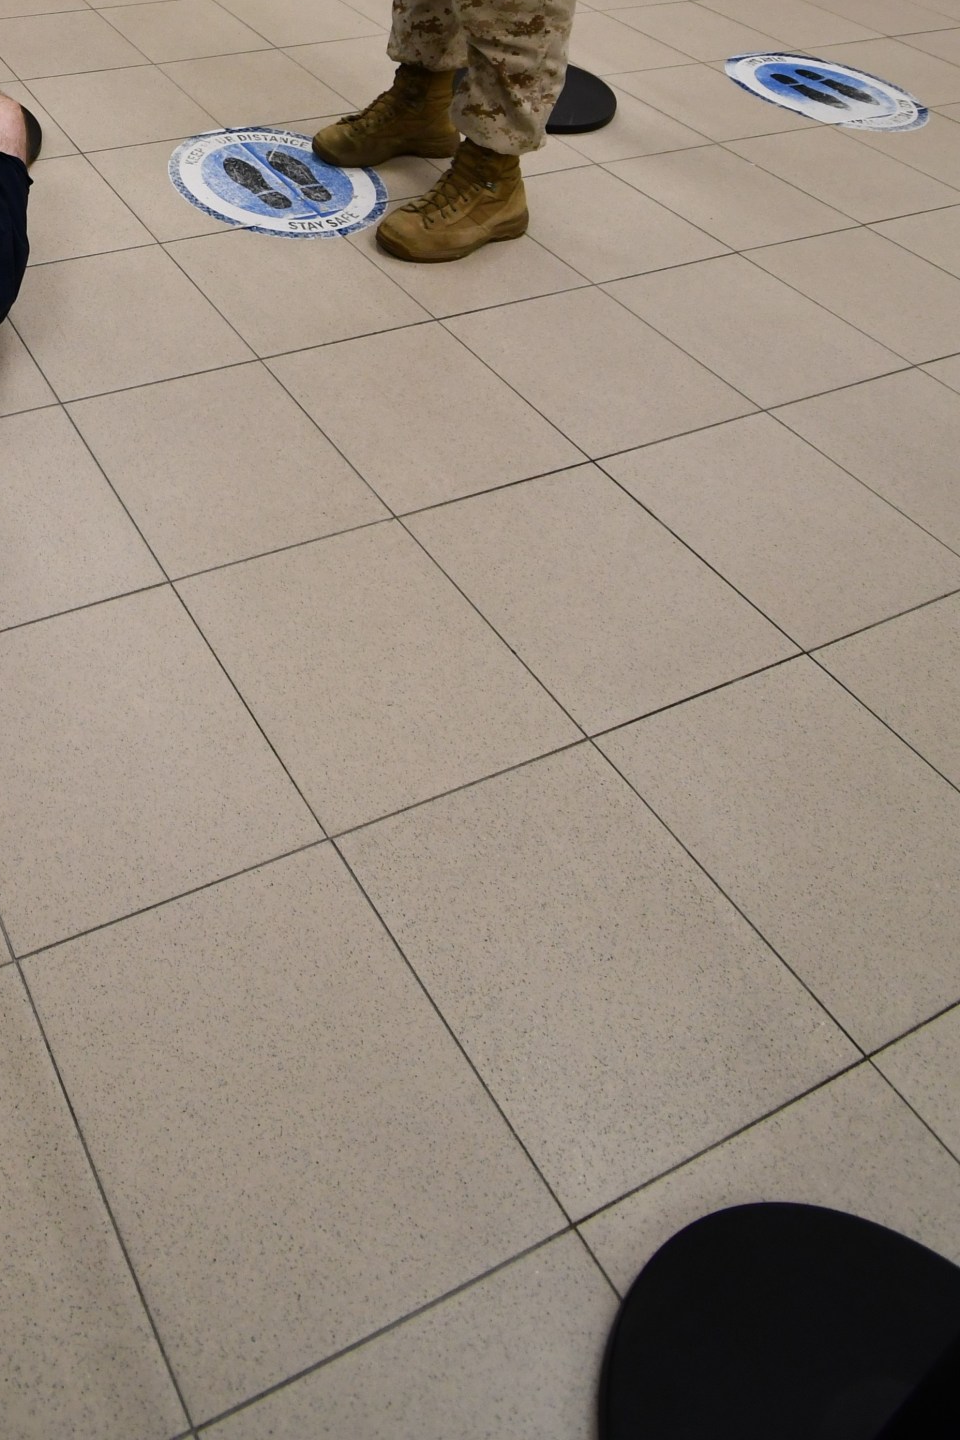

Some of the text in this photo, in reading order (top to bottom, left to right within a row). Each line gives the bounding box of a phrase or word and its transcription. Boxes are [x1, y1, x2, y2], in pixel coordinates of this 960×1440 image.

[185, 147, 205, 166] KEEP
[237, 133, 313, 150] DISTANCE
[288, 211, 360, 231] STAY SAFE
